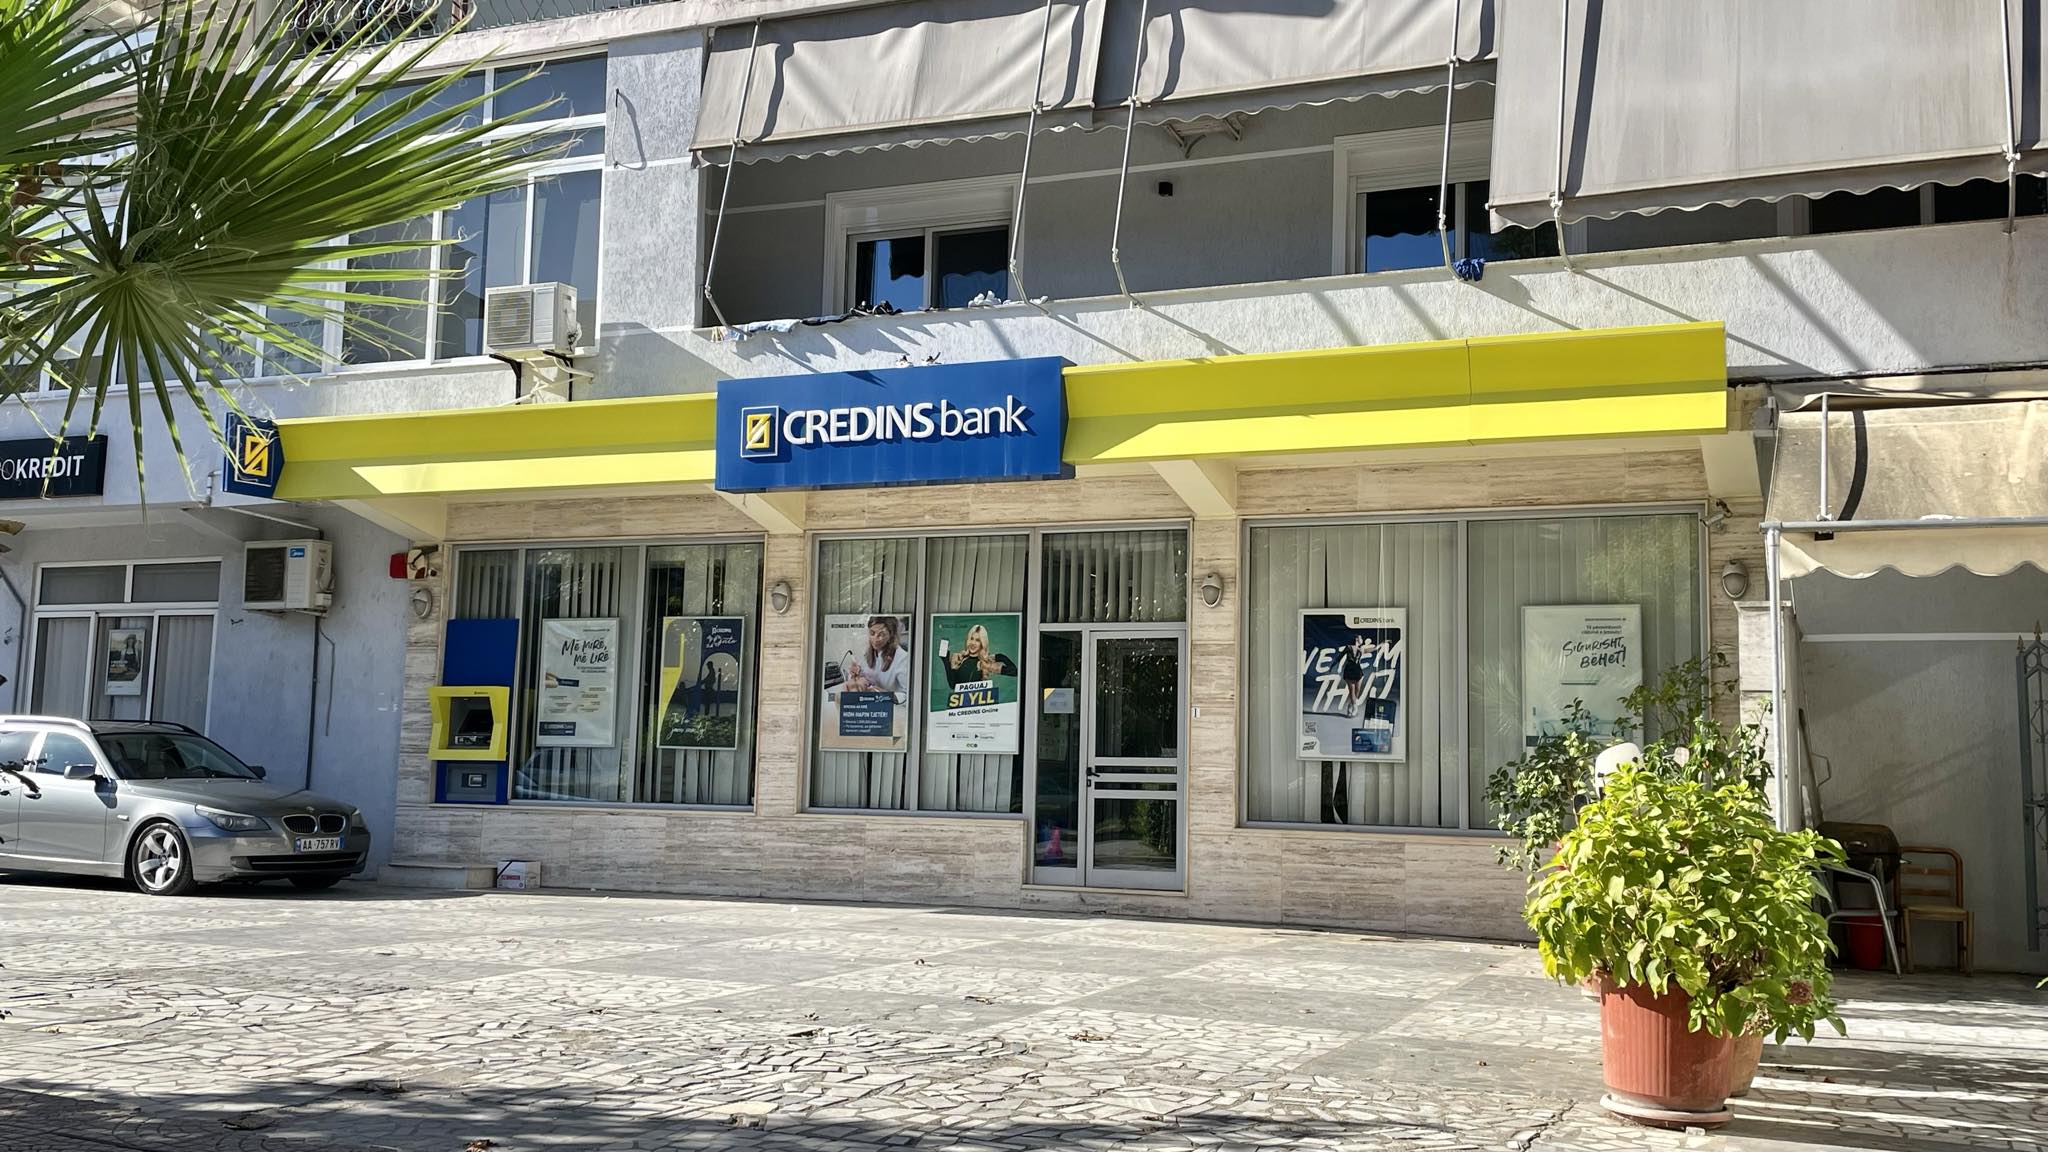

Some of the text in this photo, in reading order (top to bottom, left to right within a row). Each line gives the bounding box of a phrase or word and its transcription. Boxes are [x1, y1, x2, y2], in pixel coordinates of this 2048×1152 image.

[782, 395, 1029, 445] CREDINS bank
[0, 455, 85, 481] OKREDIT
[959, 682, 988, 691] PAGUAJ
[948, 690, 995, 708] SI YLL
[957, 709, 981, 717] CREDINS
